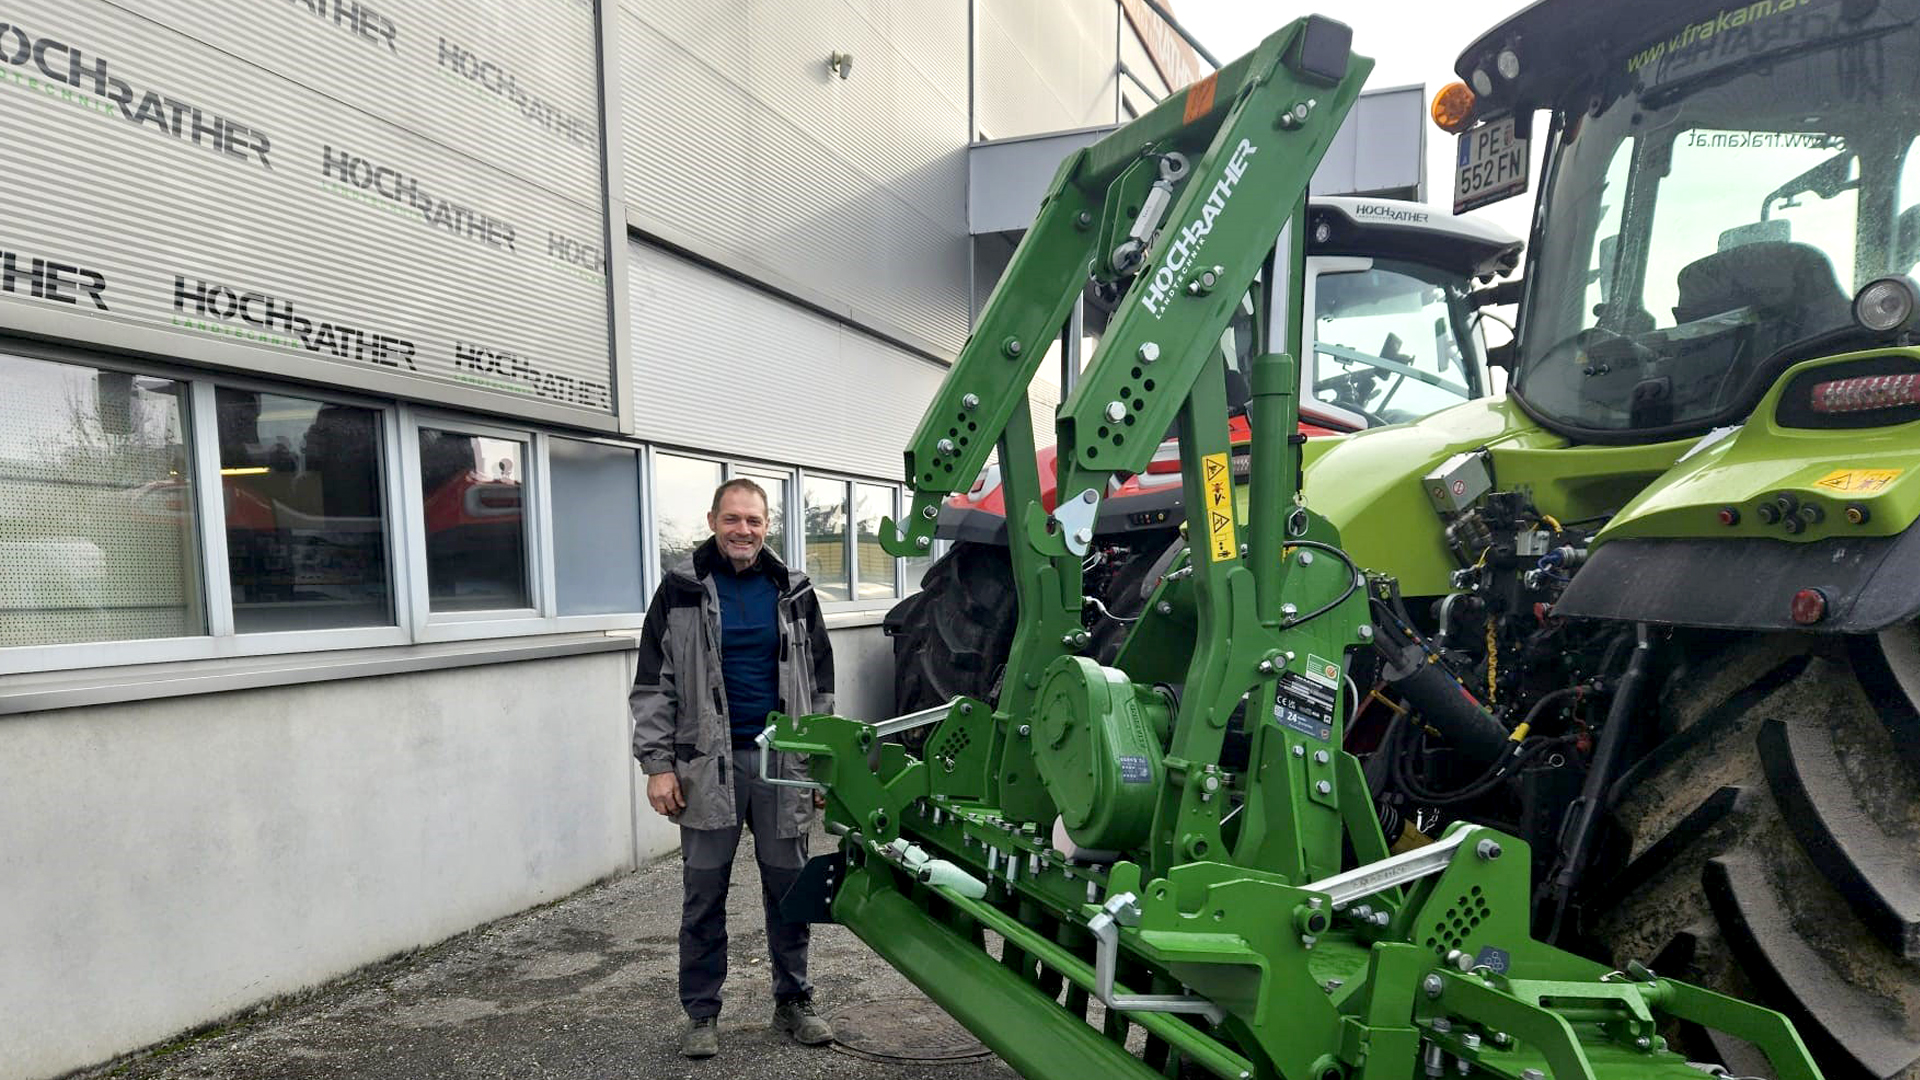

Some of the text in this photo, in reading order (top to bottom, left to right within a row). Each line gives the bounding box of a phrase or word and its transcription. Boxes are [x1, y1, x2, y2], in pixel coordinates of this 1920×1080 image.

[1627, 0, 1811, 73] www.frakam.a
[1461, 148, 1521, 194] 552 FN
[1479, 127, 1500, 161] PE
[322, 144, 517, 251] HOCHRATHER
[1142, 137, 1258, 314] HOCHRATHER
[1356, 204, 1429, 223] HOCHRATHER
[1156, 237, 1206, 320] LANDTECHNIK
[171, 314, 299, 349] LANDTECHNIK
[173, 274, 417, 371] HOCHRATHER
[455, 341, 609, 409] HOCHRATHER
